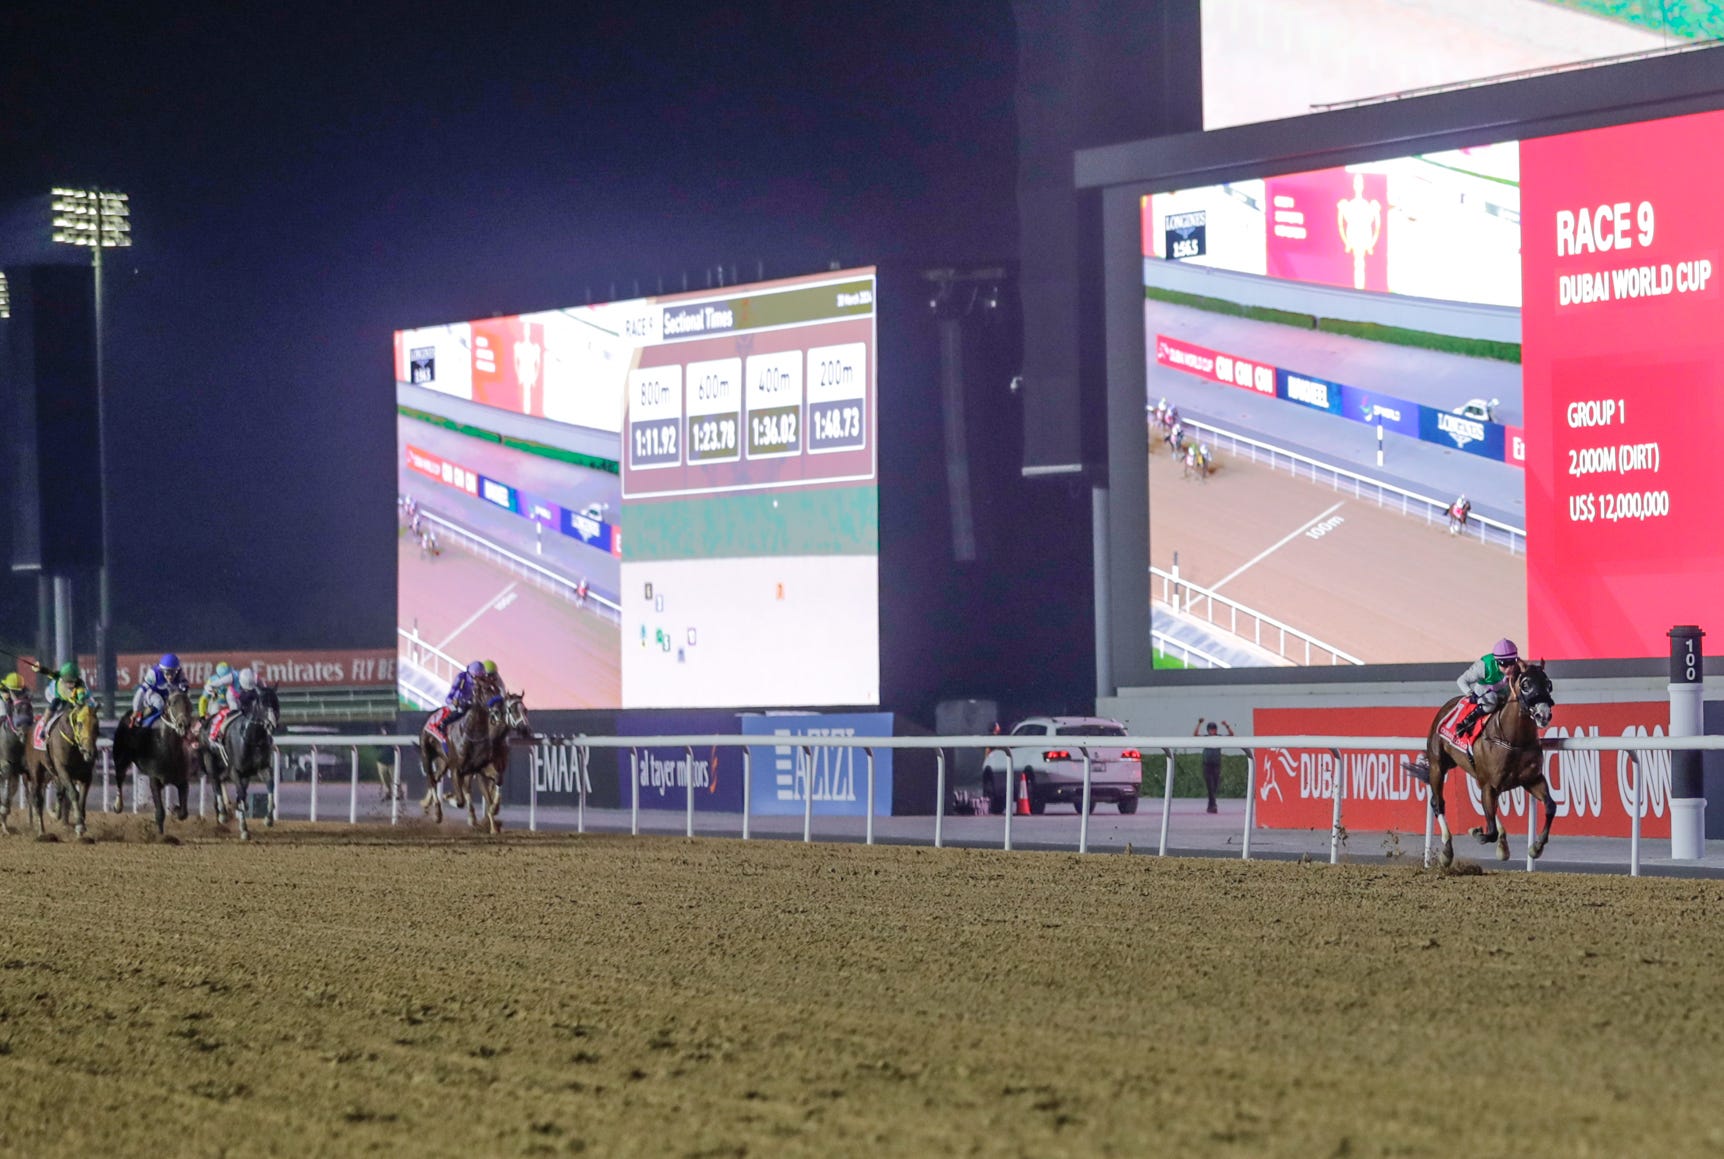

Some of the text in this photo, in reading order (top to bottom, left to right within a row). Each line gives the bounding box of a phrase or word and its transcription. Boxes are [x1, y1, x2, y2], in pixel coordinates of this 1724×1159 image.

[1556, 201, 1655, 257] RACE 9
[1559, 259, 1712, 306] DUBAI WORLD CUP
[664, 307, 734, 335] Sectional Times
[698, 374, 730, 400] 600m
[758, 367, 791, 393] 400m
[820, 360, 853, 387] 200m
[641, 381, 670, 406] 800m
[1567, 399, 1625, 428] GROUP 1
[635, 425, 677, 457] 1:11.92
[693, 419, 736, 451] 1:23.78
[752, 413, 796, 447] 1:36.02
[1568, 442, 1660, 478] 2,000M (DIRT)
[1569, 490, 1670, 523] US$ 12,000,000
[1305, 515, 1345, 540] 100m
[252, 659, 345, 682] Emirates
[352, 658, 375, 681] FLY
[1685, 638, 1696, 681] 100
[640, 749, 710, 797] al tayer mtors
[793, 728, 857, 801] AZIZI
[1301, 752, 1349, 800] DUBI
[1352, 752, 1412, 801] WORLD
